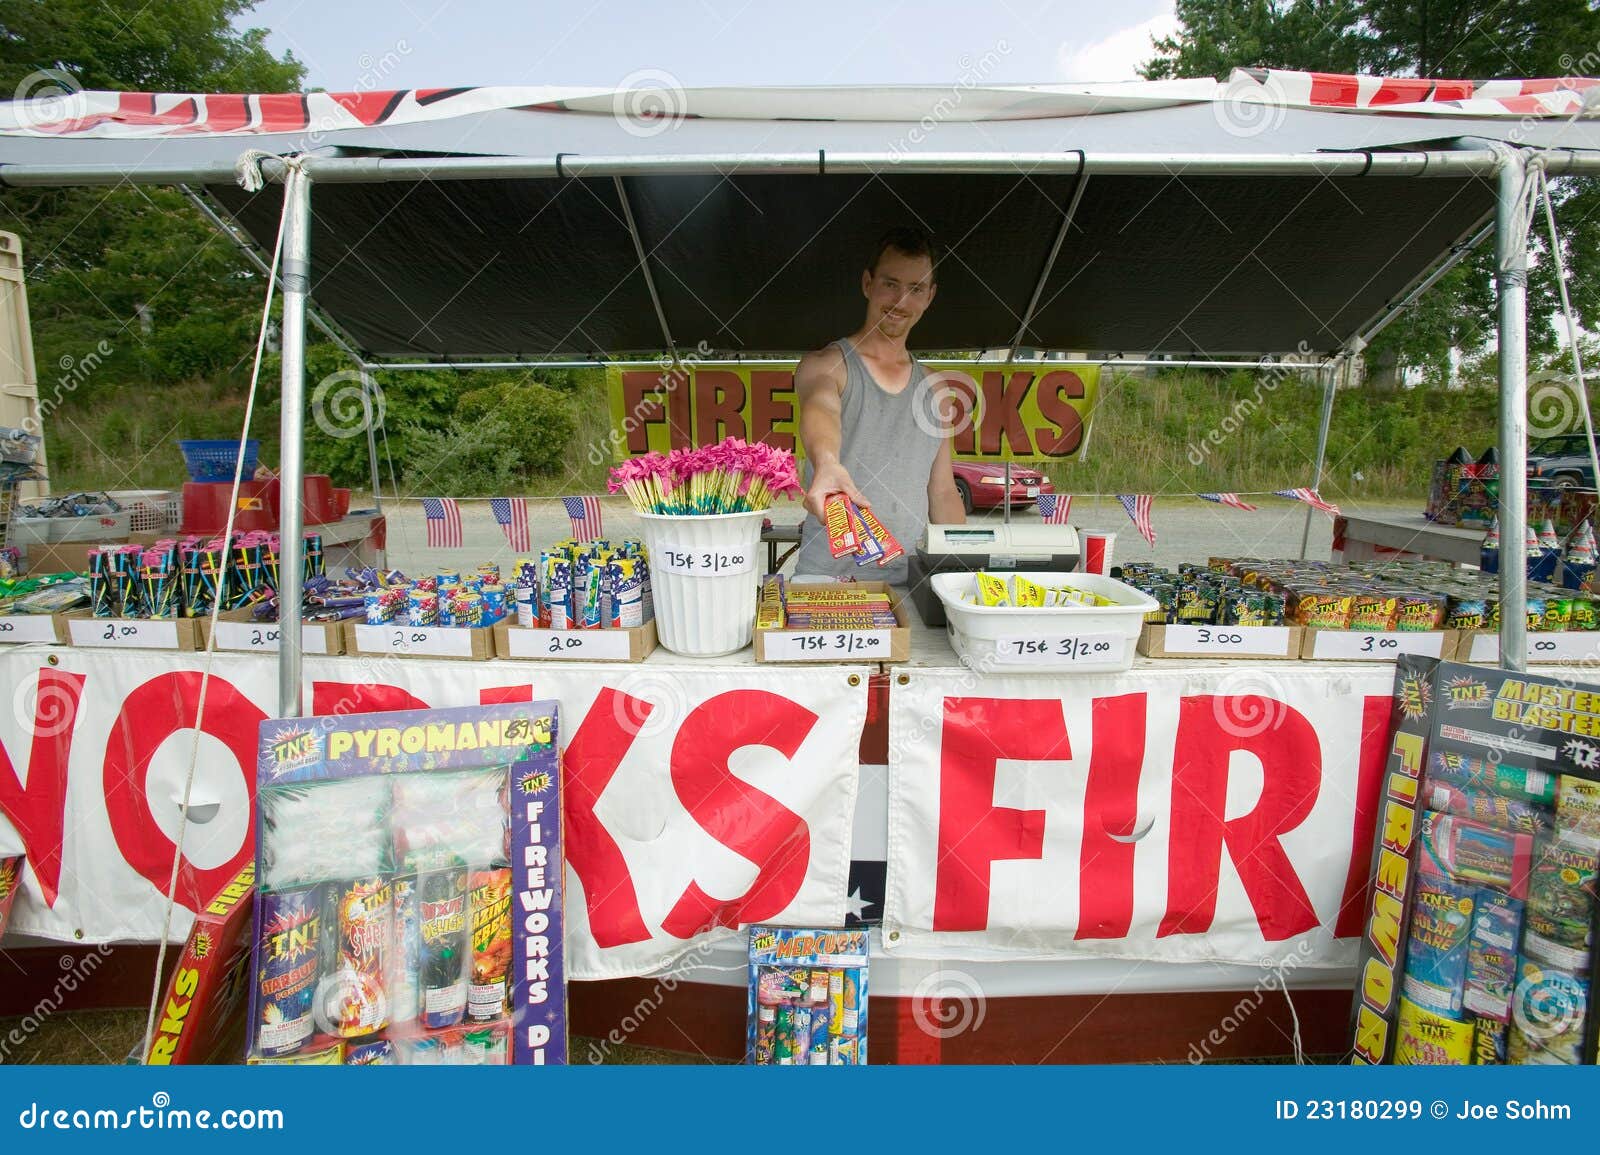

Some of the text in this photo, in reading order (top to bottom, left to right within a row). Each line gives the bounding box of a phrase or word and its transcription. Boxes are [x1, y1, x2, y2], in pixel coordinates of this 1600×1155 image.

[1320, 603, 1338, 613] TNT
[1360, 603, 1380, 613] TNT
[1405, 603, 1426, 614] TNT
[1456, 614, 1481, 627] TNT
[1197, 629, 1242, 643] 3.00
[1404, 679, 1425, 713] TNT
[1450, 685, 1484, 701] TNT
[1497, 679, 1600, 715] MASTER
[1493, 698, 1600, 739] BLASTER
[275, 733, 313, 763] TNT
[521, 775, 549, 794] TNT
[362, 885, 393, 911] TNT
[520, 801, 553, 1004] FIREWORKS
[1354, 731, 1424, 1065] FIREWOR
[1422, 893, 1454, 907] TNT
[197, 934, 207, 957] TNT
[271, 918, 320, 958] TNT
[755, 937, 775, 951] TNT
[1422, 1023, 1448, 1037] TNT
